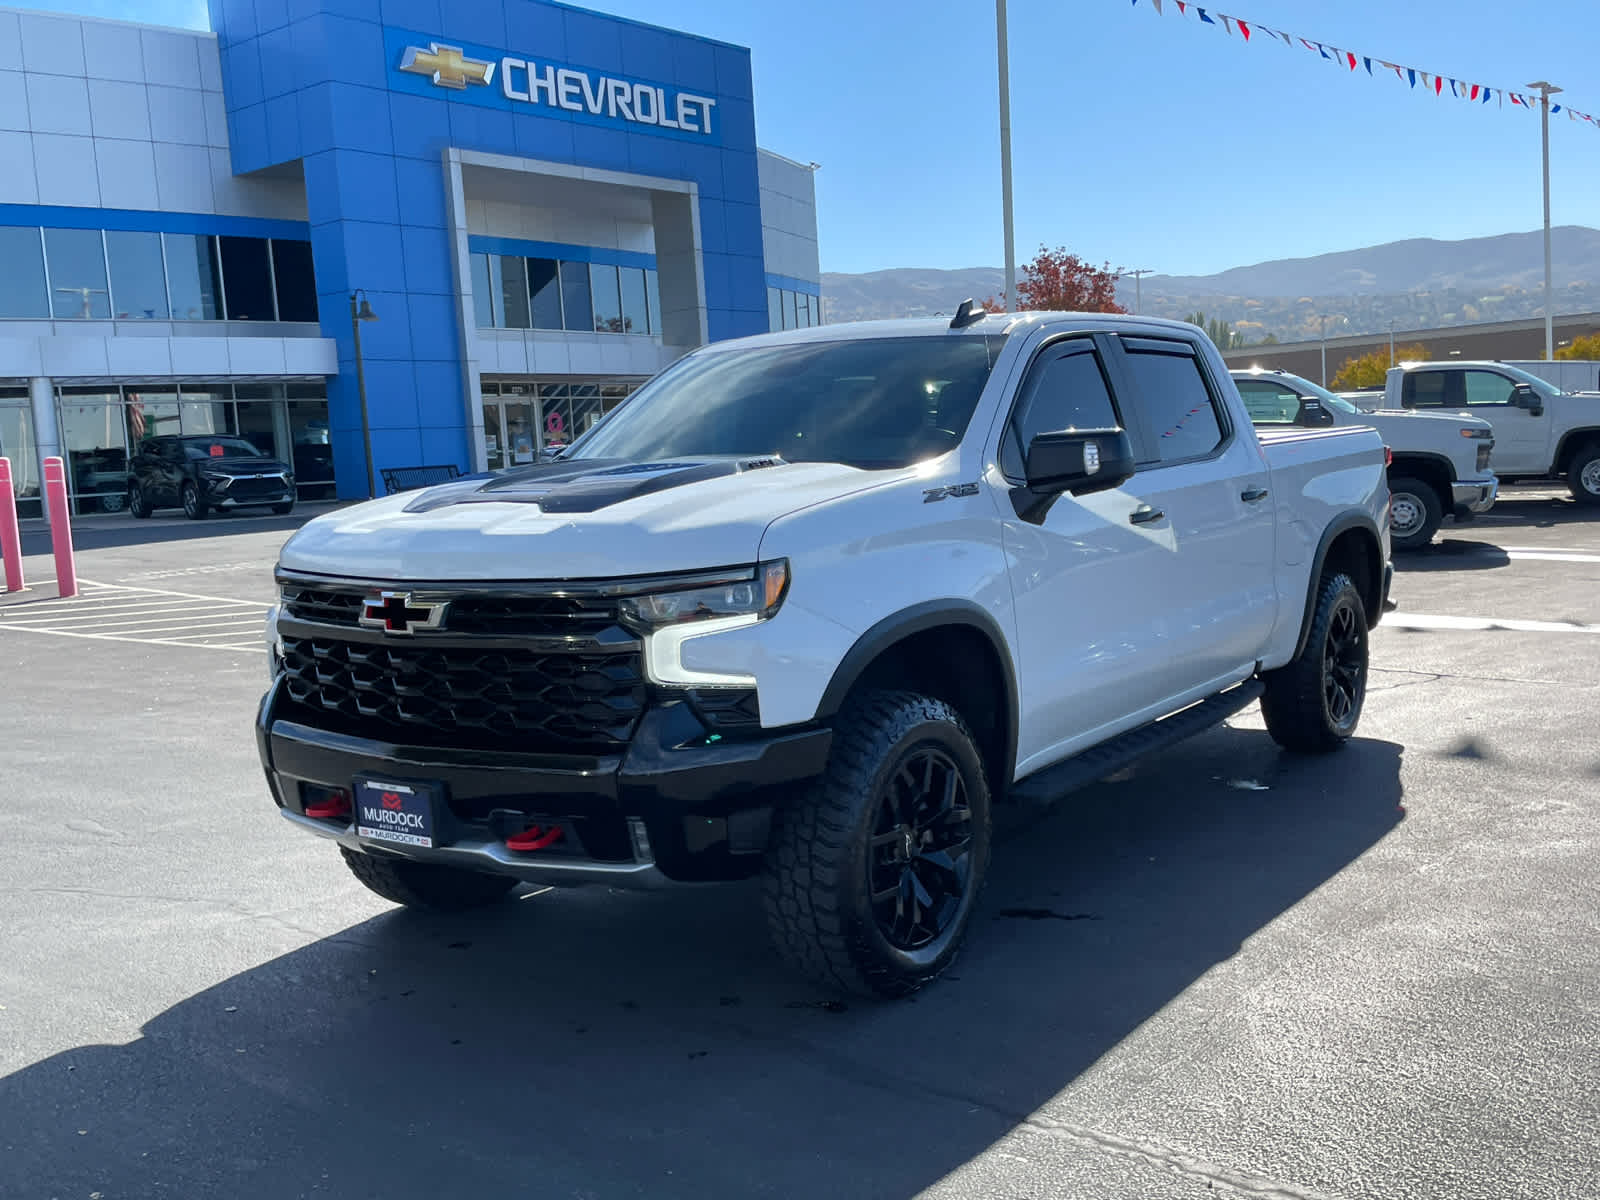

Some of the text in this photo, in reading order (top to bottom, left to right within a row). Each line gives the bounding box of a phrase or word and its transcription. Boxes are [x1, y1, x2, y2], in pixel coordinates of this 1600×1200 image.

[501, 56, 716, 135] CHEVROLET
[363, 806, 424, 829] MURDOCK
[374, 830, 415, 843] MURDOCK
